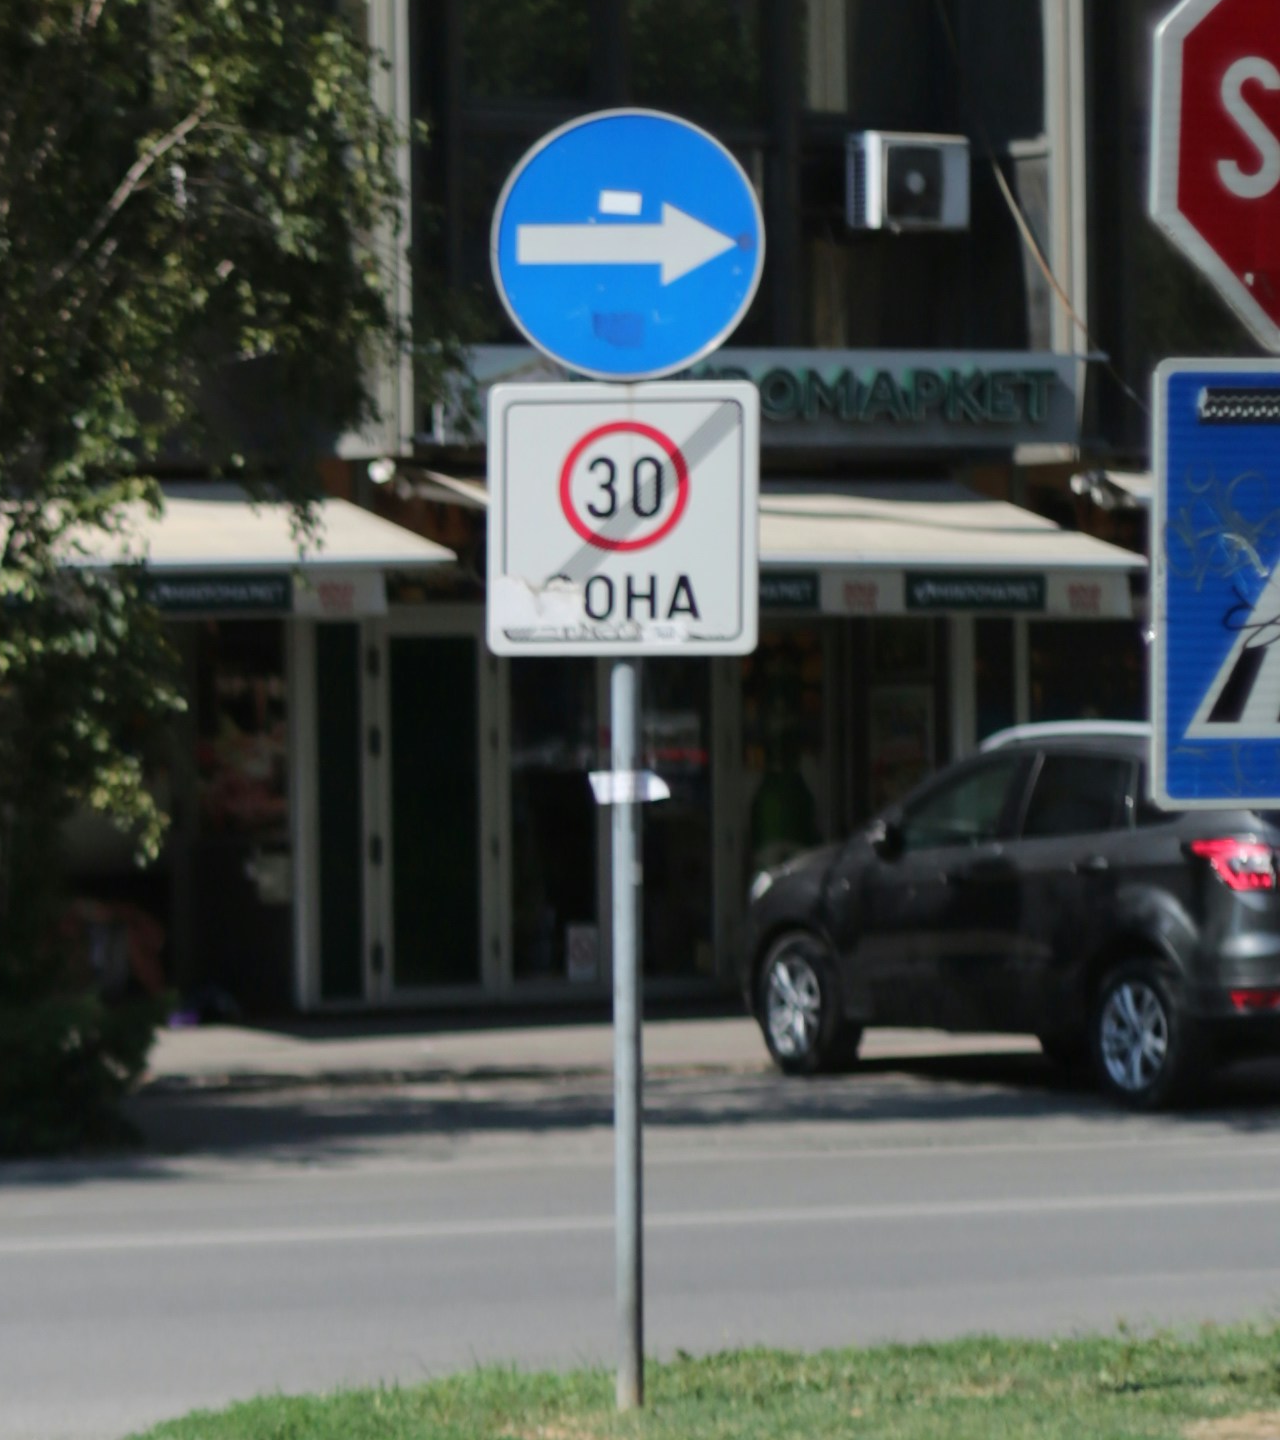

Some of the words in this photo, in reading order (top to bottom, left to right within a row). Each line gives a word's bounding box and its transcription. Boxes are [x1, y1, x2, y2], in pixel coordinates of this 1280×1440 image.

[569, 364, 1058, 424] ОМАРКЕТ
[586, 456, 664, 519] 30
[545, 574, 701, 621] ОНА
